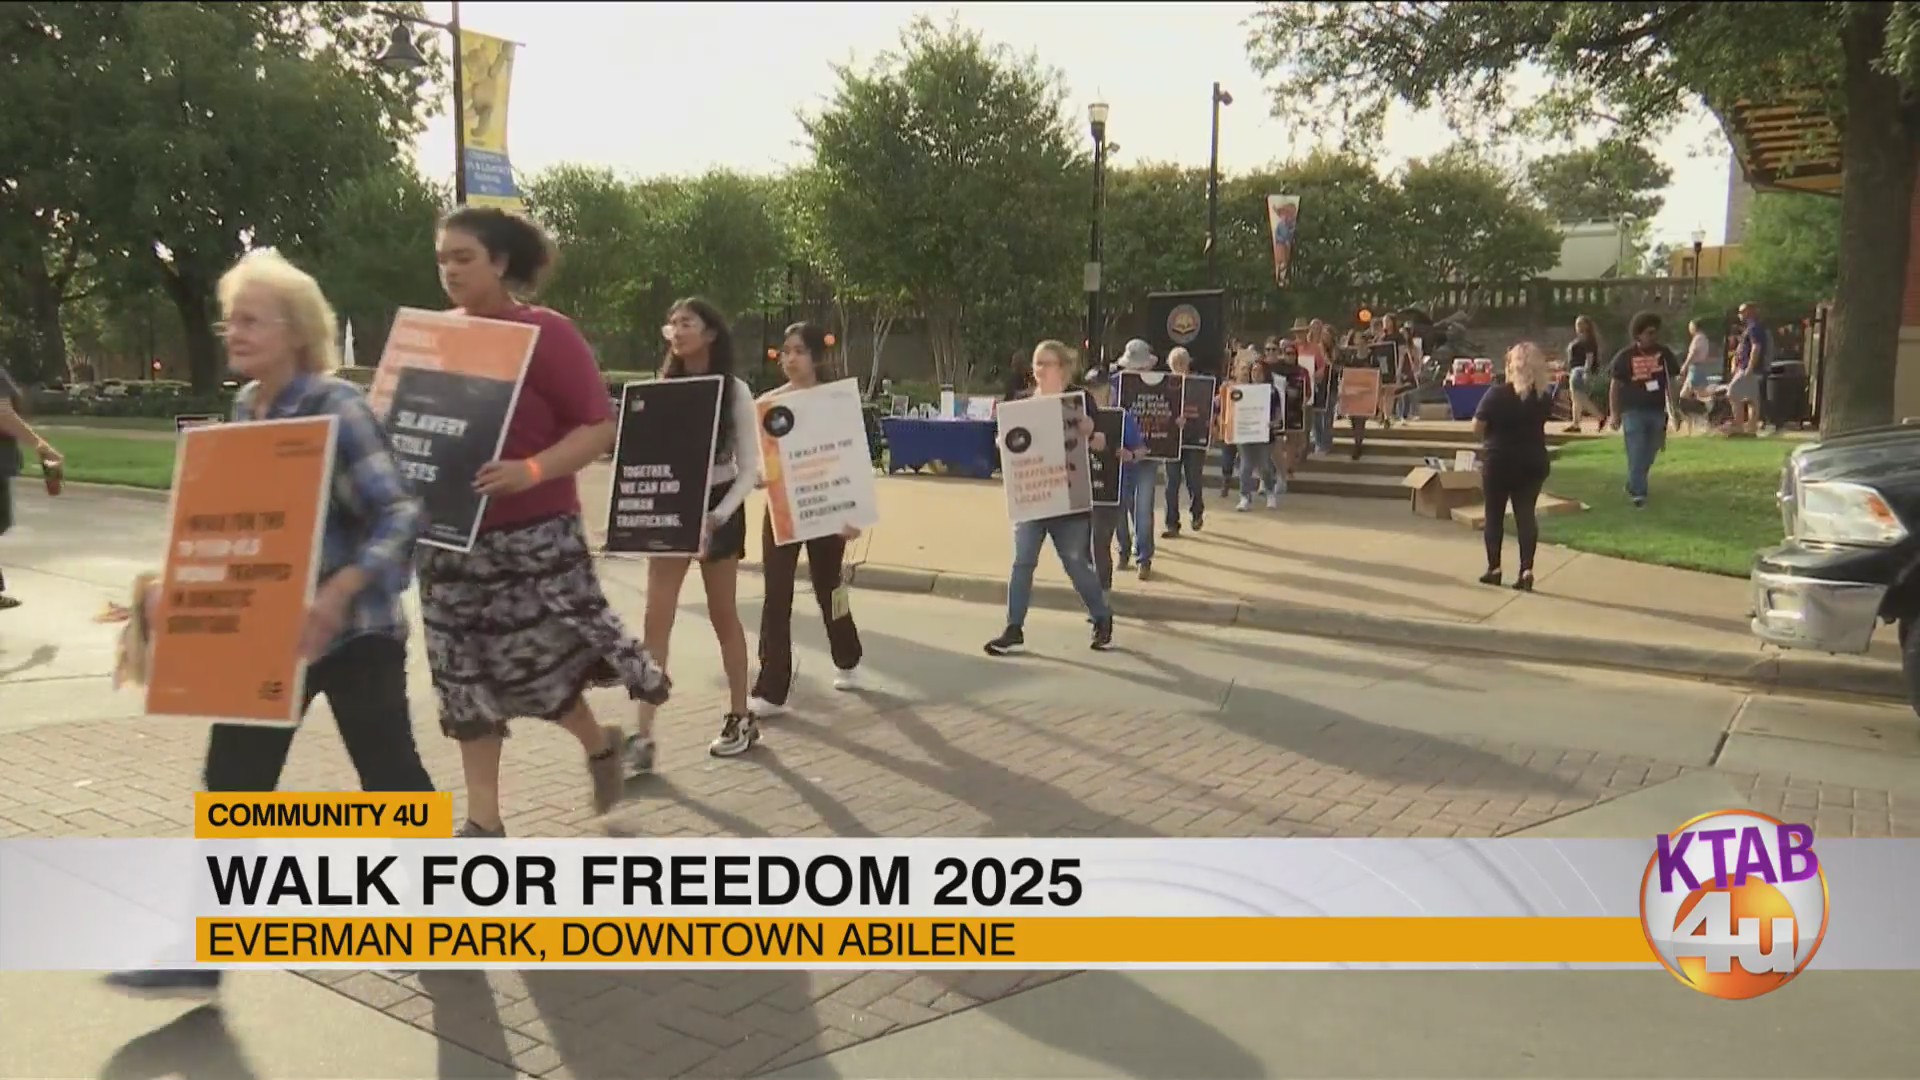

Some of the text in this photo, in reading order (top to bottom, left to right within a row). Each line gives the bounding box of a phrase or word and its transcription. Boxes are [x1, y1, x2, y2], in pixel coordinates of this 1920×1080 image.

[395, 410, 468, 437] SLAVERY
[623, 464, 673, 479] TOGETHER,
[620, 480, 680, 495] WE CAN END
